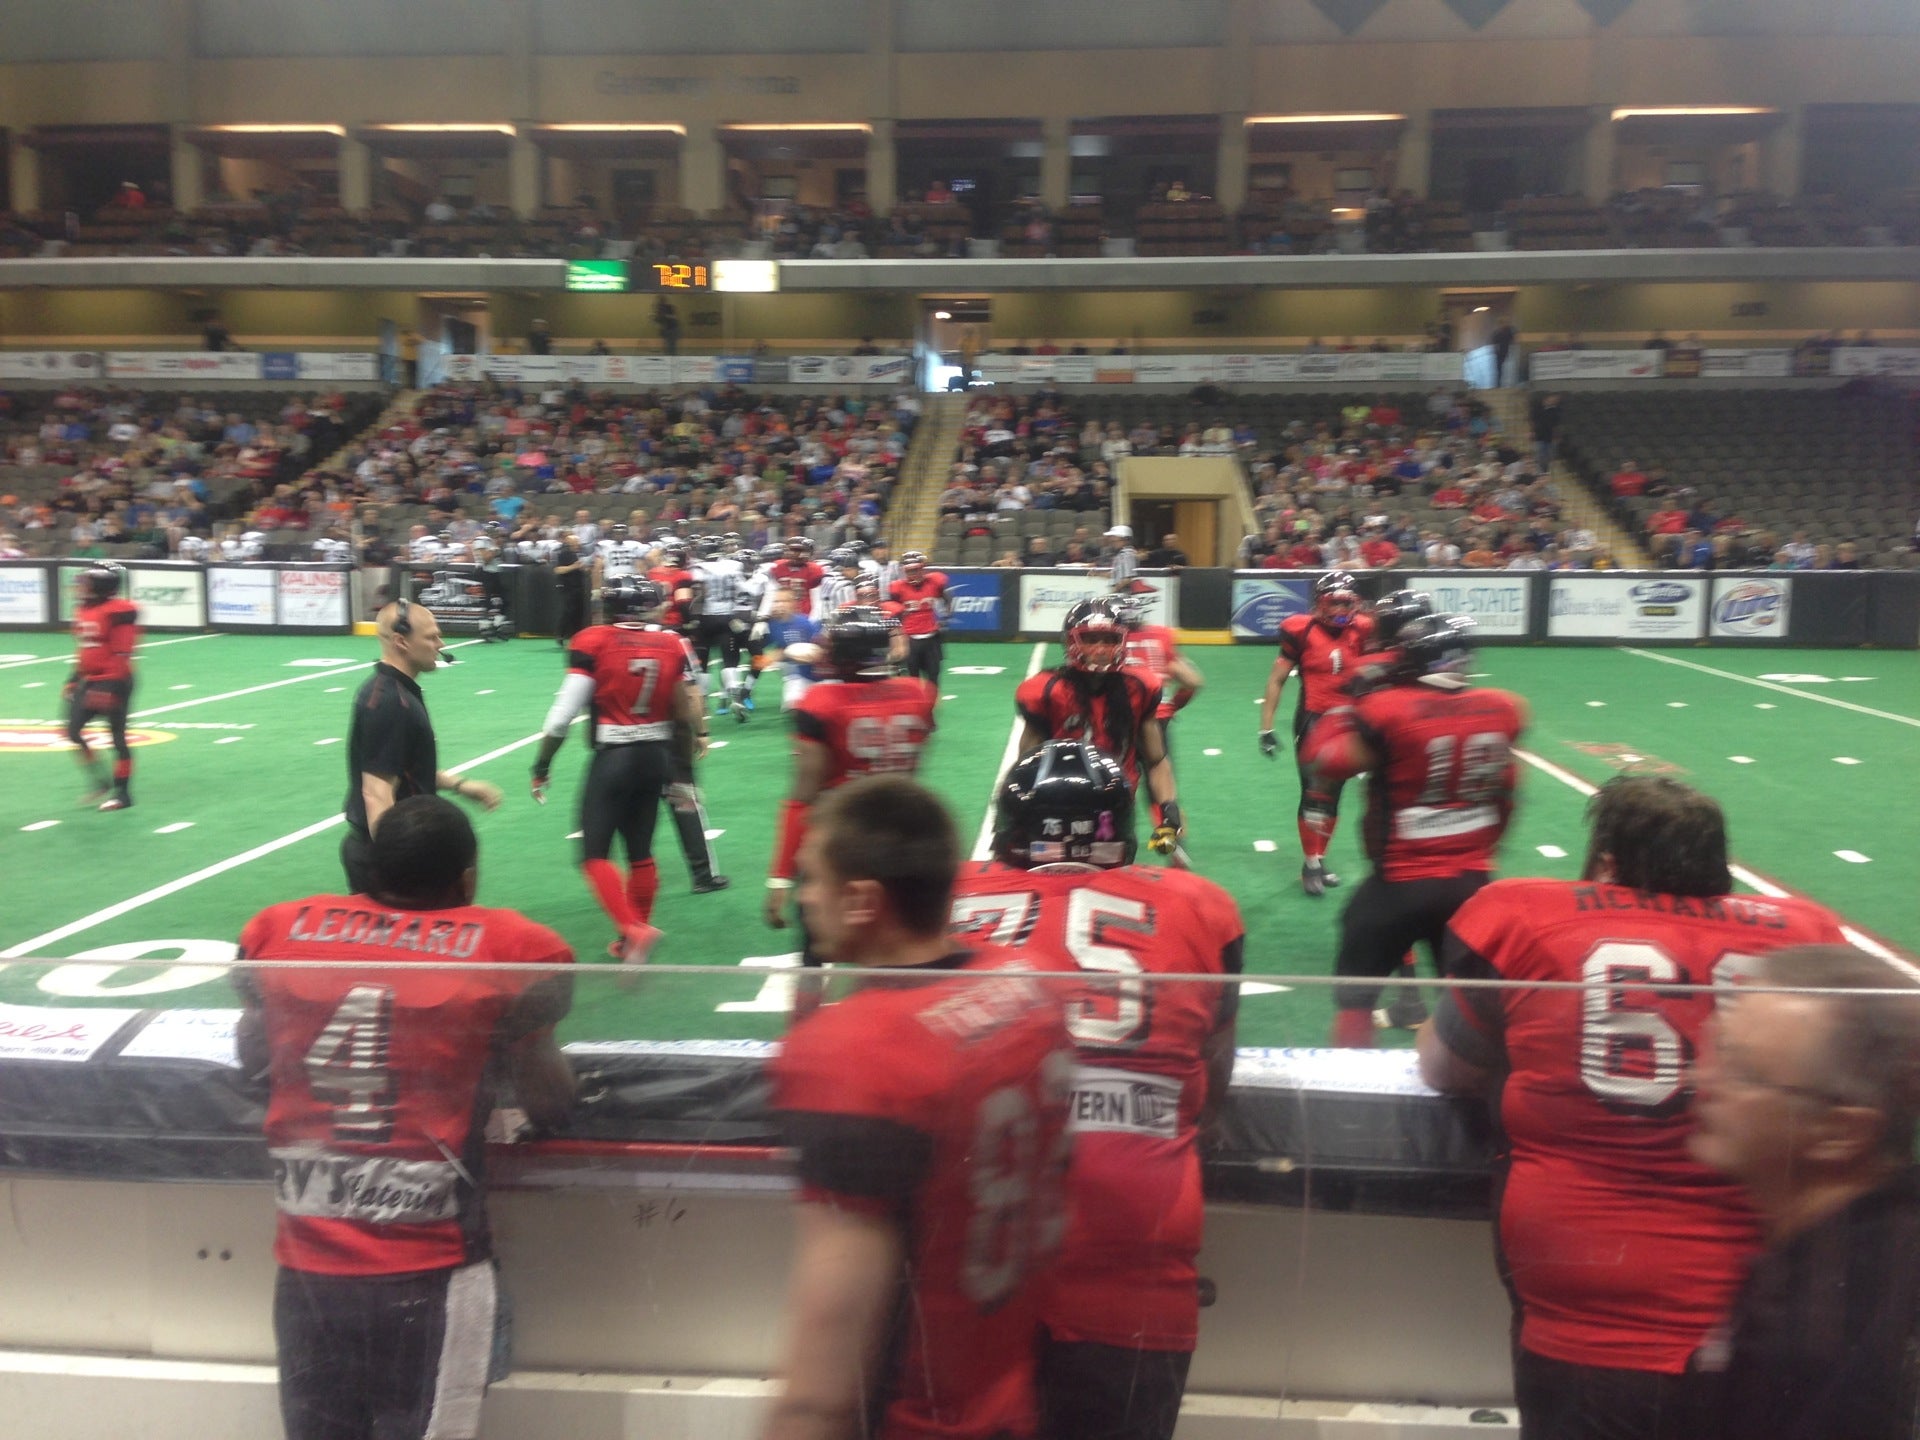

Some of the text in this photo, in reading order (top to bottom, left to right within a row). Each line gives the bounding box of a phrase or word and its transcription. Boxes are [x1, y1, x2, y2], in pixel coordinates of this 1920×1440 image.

[949, 595, 1000, 613] IGHT
[627, 658, 661, 715] 7
[287, 905, 485, 959] LEONARD
[302, 982, 395, 1142] 4
